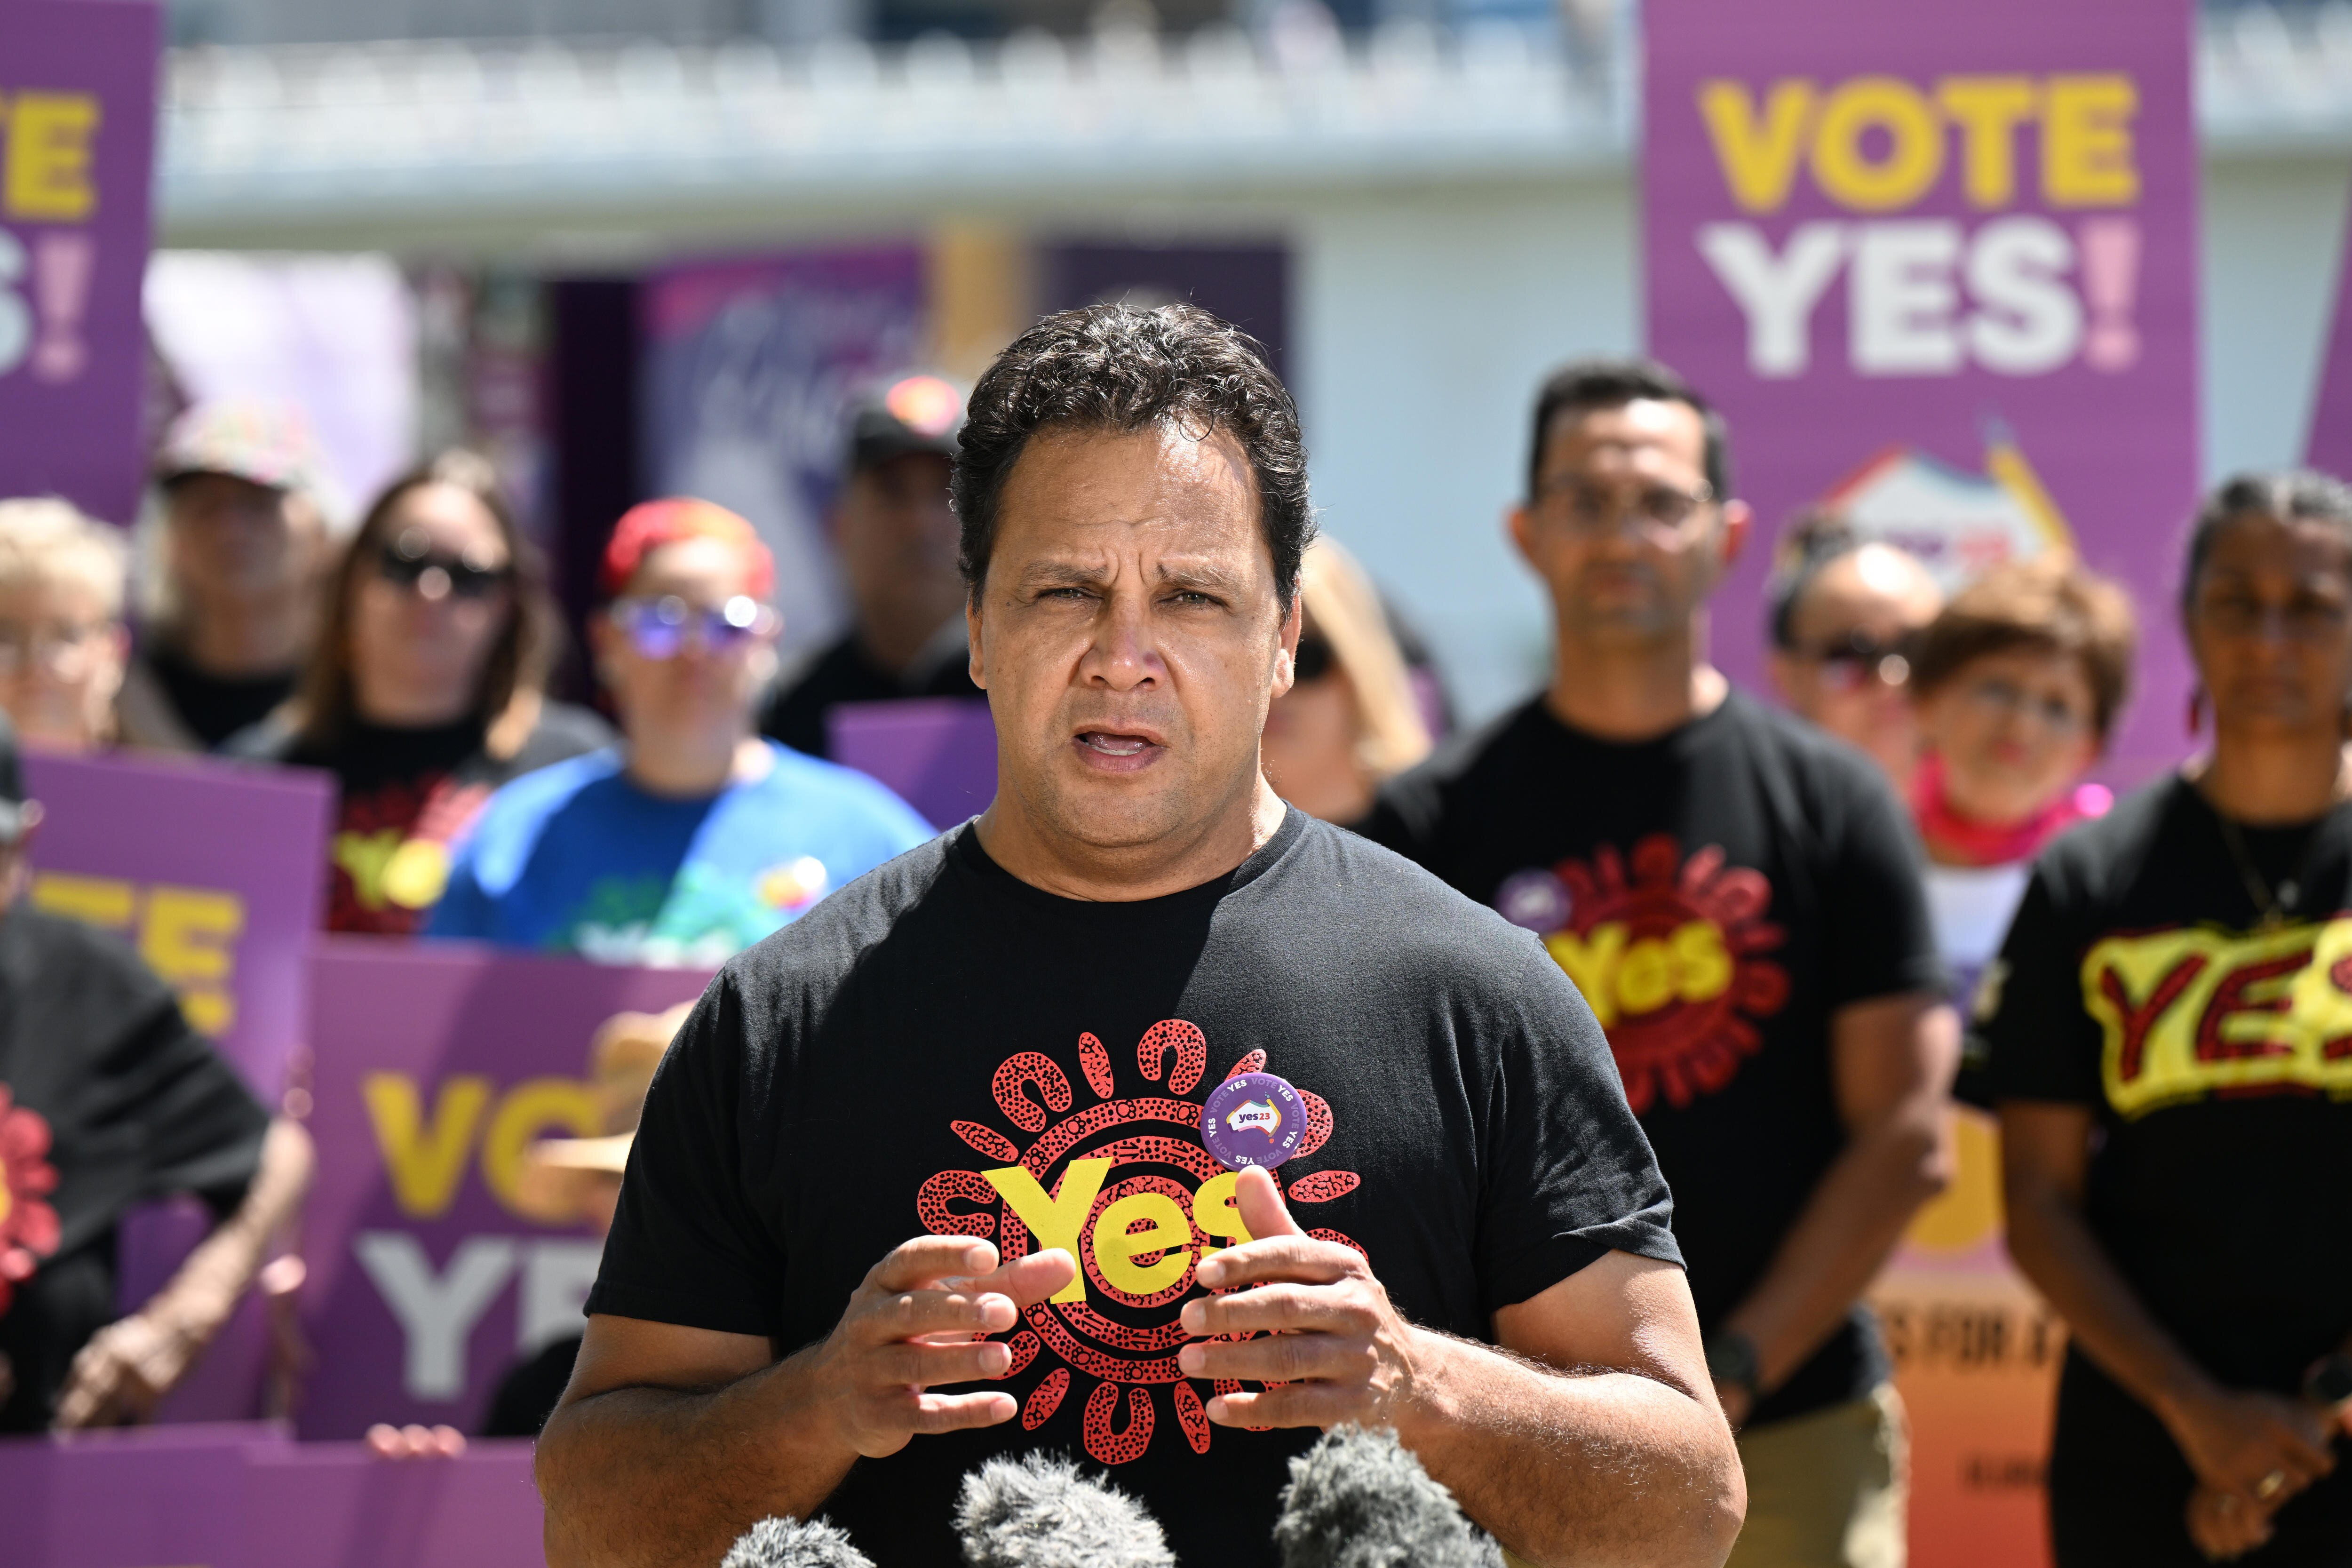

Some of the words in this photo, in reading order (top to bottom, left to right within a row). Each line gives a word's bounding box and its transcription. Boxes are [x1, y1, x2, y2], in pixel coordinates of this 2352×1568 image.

[0, 89, 100, 222] E
[1700, 74, 2140, 214] VOTE
[1698, 215, 2141, 377] YES!
[1210, 1090, 1229, 1113] VOTE
[1227, 1080, 1247, 1092] YES
[1251, 1078, 1278, 1089] VOTE
[1277, 1084, 1293, 1102] YES
[1208, 1118, 1217, 1138] YES
[1239, 1113, 1270, 1123] yes23
[1291, 1103, 1300, 1129] VOTE
[1212, 1137, 1232, 1159] VOTE
[1282, 1131, 1298, 1148] YES
[1235, 1155, 1255, 1165] YES
[1256, 1149, 1284, 1163] VOTE
[980, 1156, 1255, 1304] Yes
